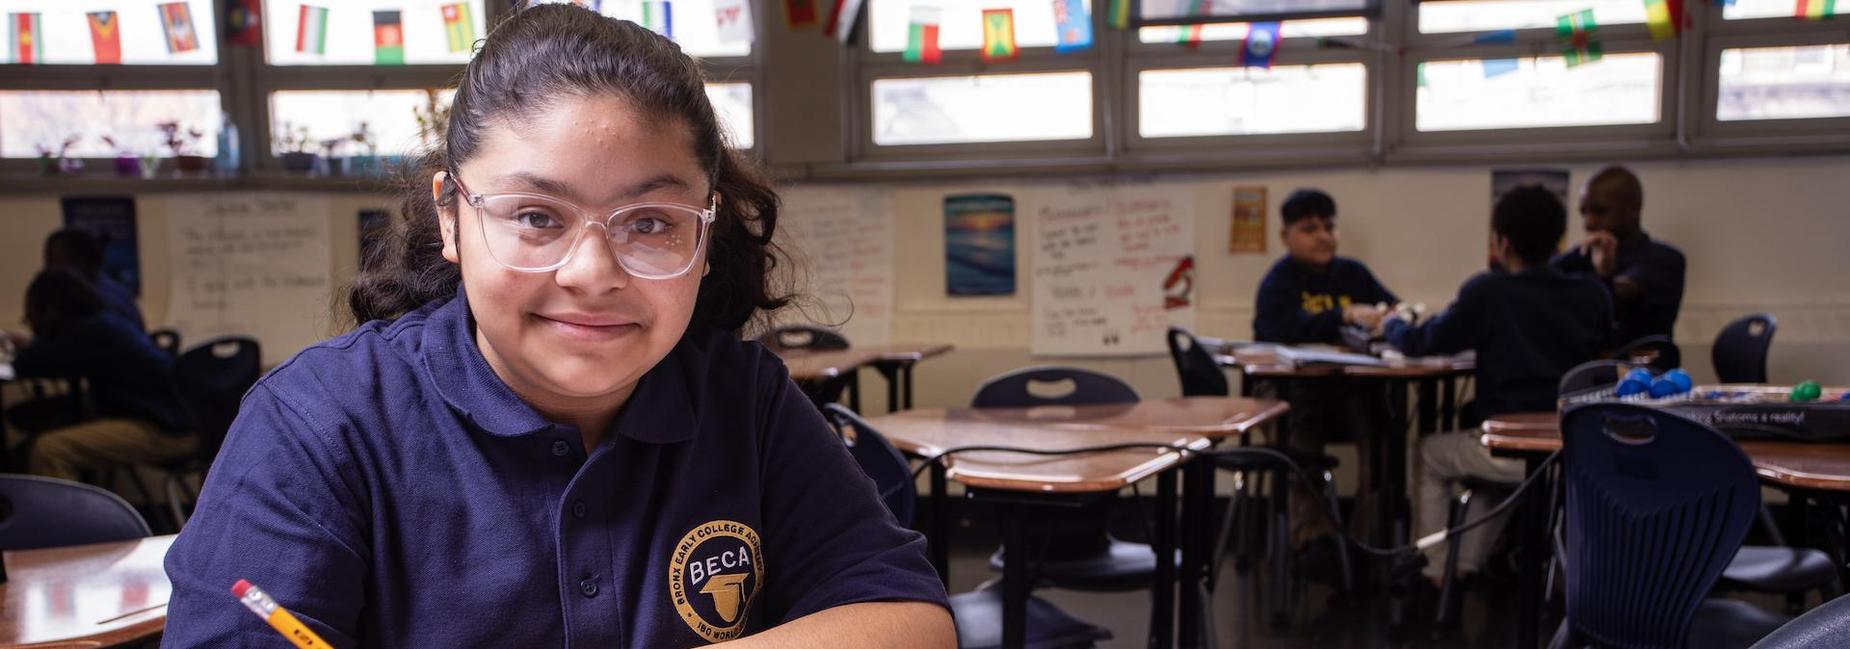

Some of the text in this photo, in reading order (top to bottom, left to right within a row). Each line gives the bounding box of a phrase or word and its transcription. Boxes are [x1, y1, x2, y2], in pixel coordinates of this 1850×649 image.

[697, 524, 745, 538] COLLEGE
[675, 535, 697, 565] EARLY
[689, 546, 750, 586] BECA
[672, 567, 685, 605] BRONX
